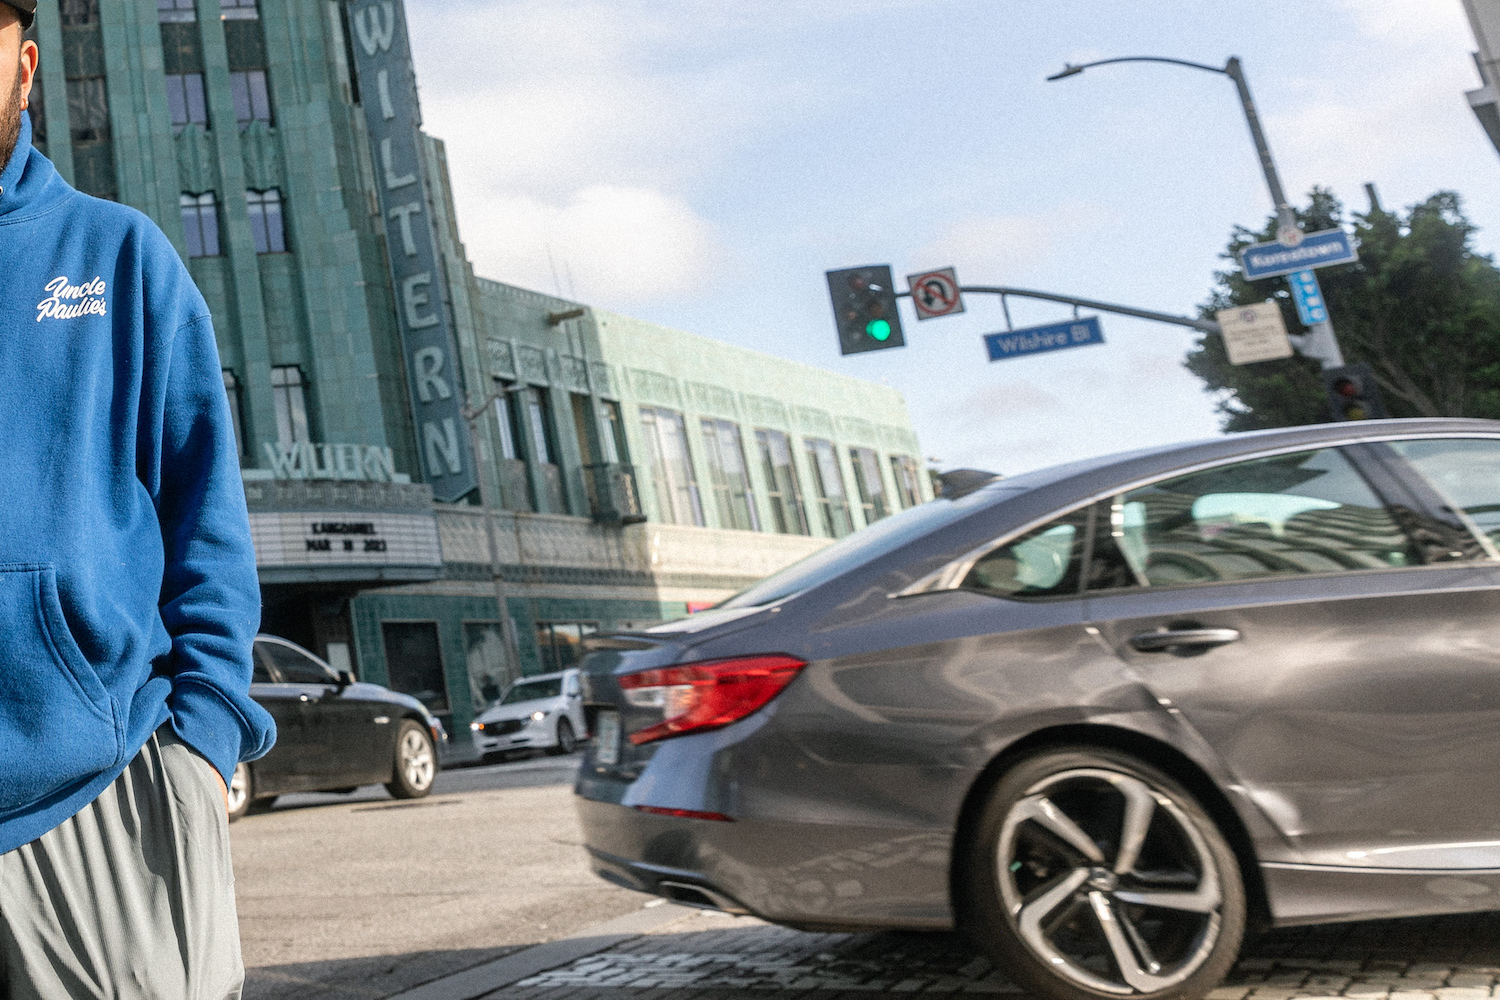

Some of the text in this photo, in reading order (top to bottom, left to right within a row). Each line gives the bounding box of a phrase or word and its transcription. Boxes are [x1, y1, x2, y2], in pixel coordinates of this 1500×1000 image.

[353, 6, 461, 478] WILTERN
[44, 275, 107, 299] Uncle
[36, 296, 107, 323] Paulie's
[997, 330, 1068, 354] Wilshire
[306, 539, 331, 551] MAR
